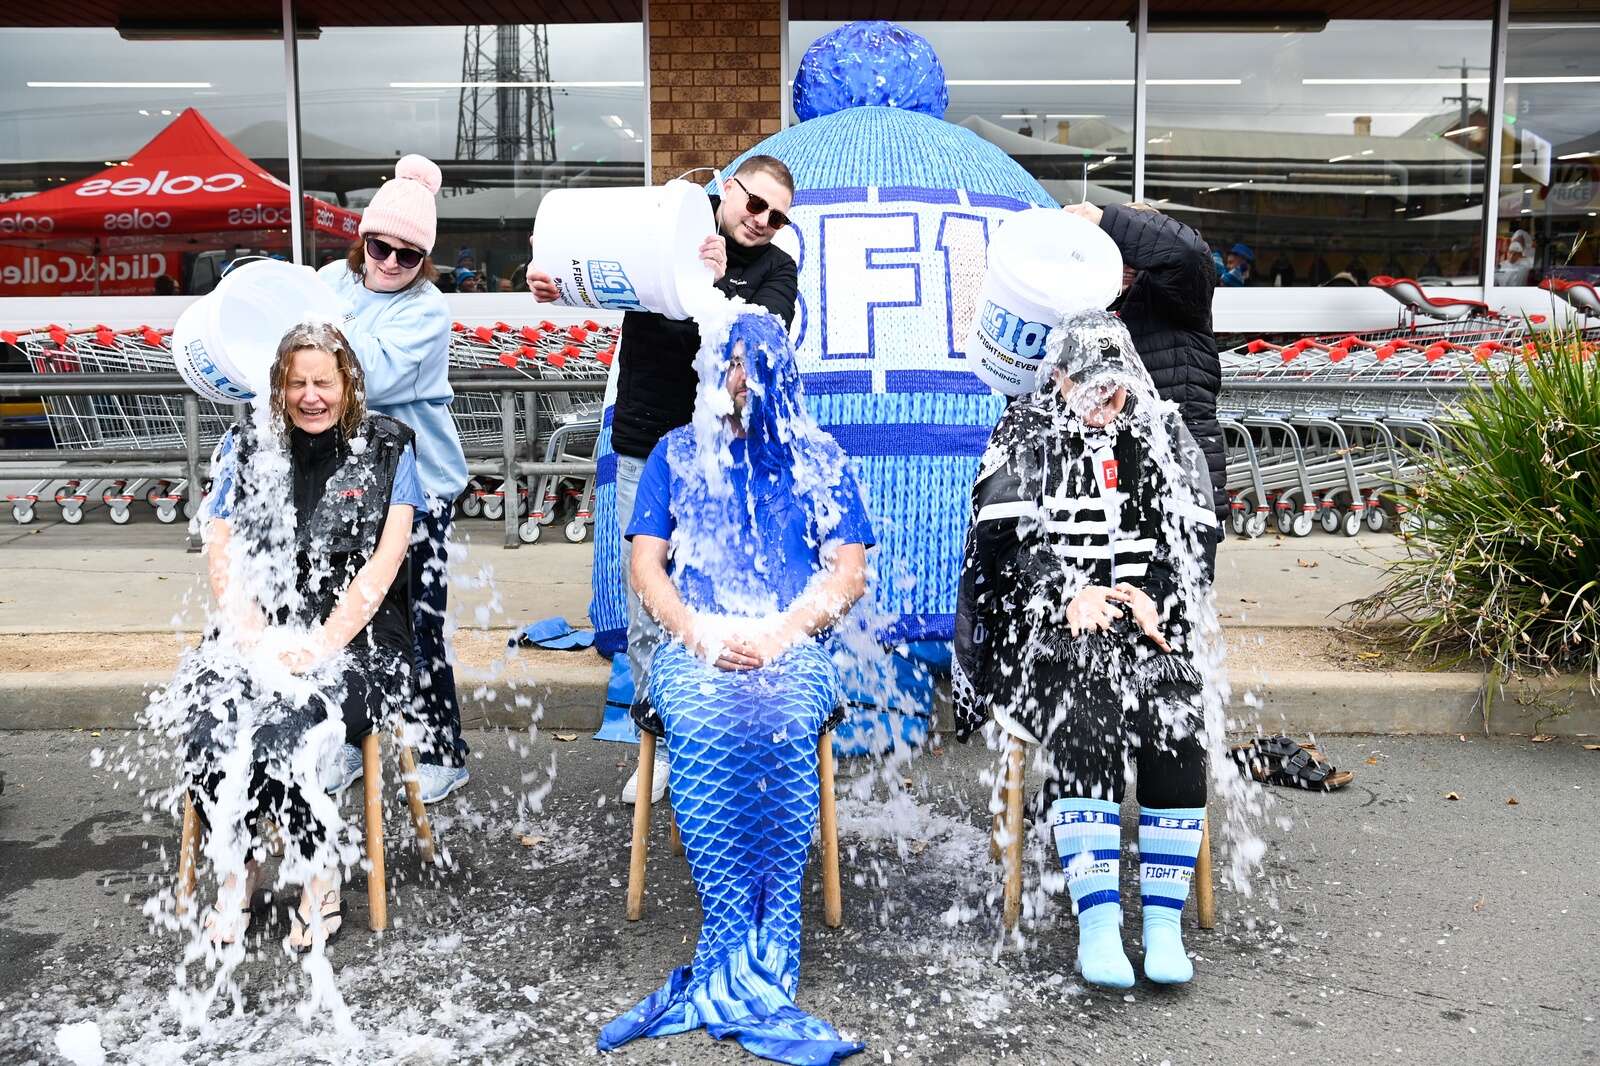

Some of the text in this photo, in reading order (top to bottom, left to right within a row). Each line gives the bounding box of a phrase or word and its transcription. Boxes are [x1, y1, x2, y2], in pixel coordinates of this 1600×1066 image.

[1553, 187, 1590, 200] PRICE
[998, 312, 1052, 359] 10
[1015, 360, 1039, 372] EVEN
[1145, 866, 1179, 879] FIGHT
